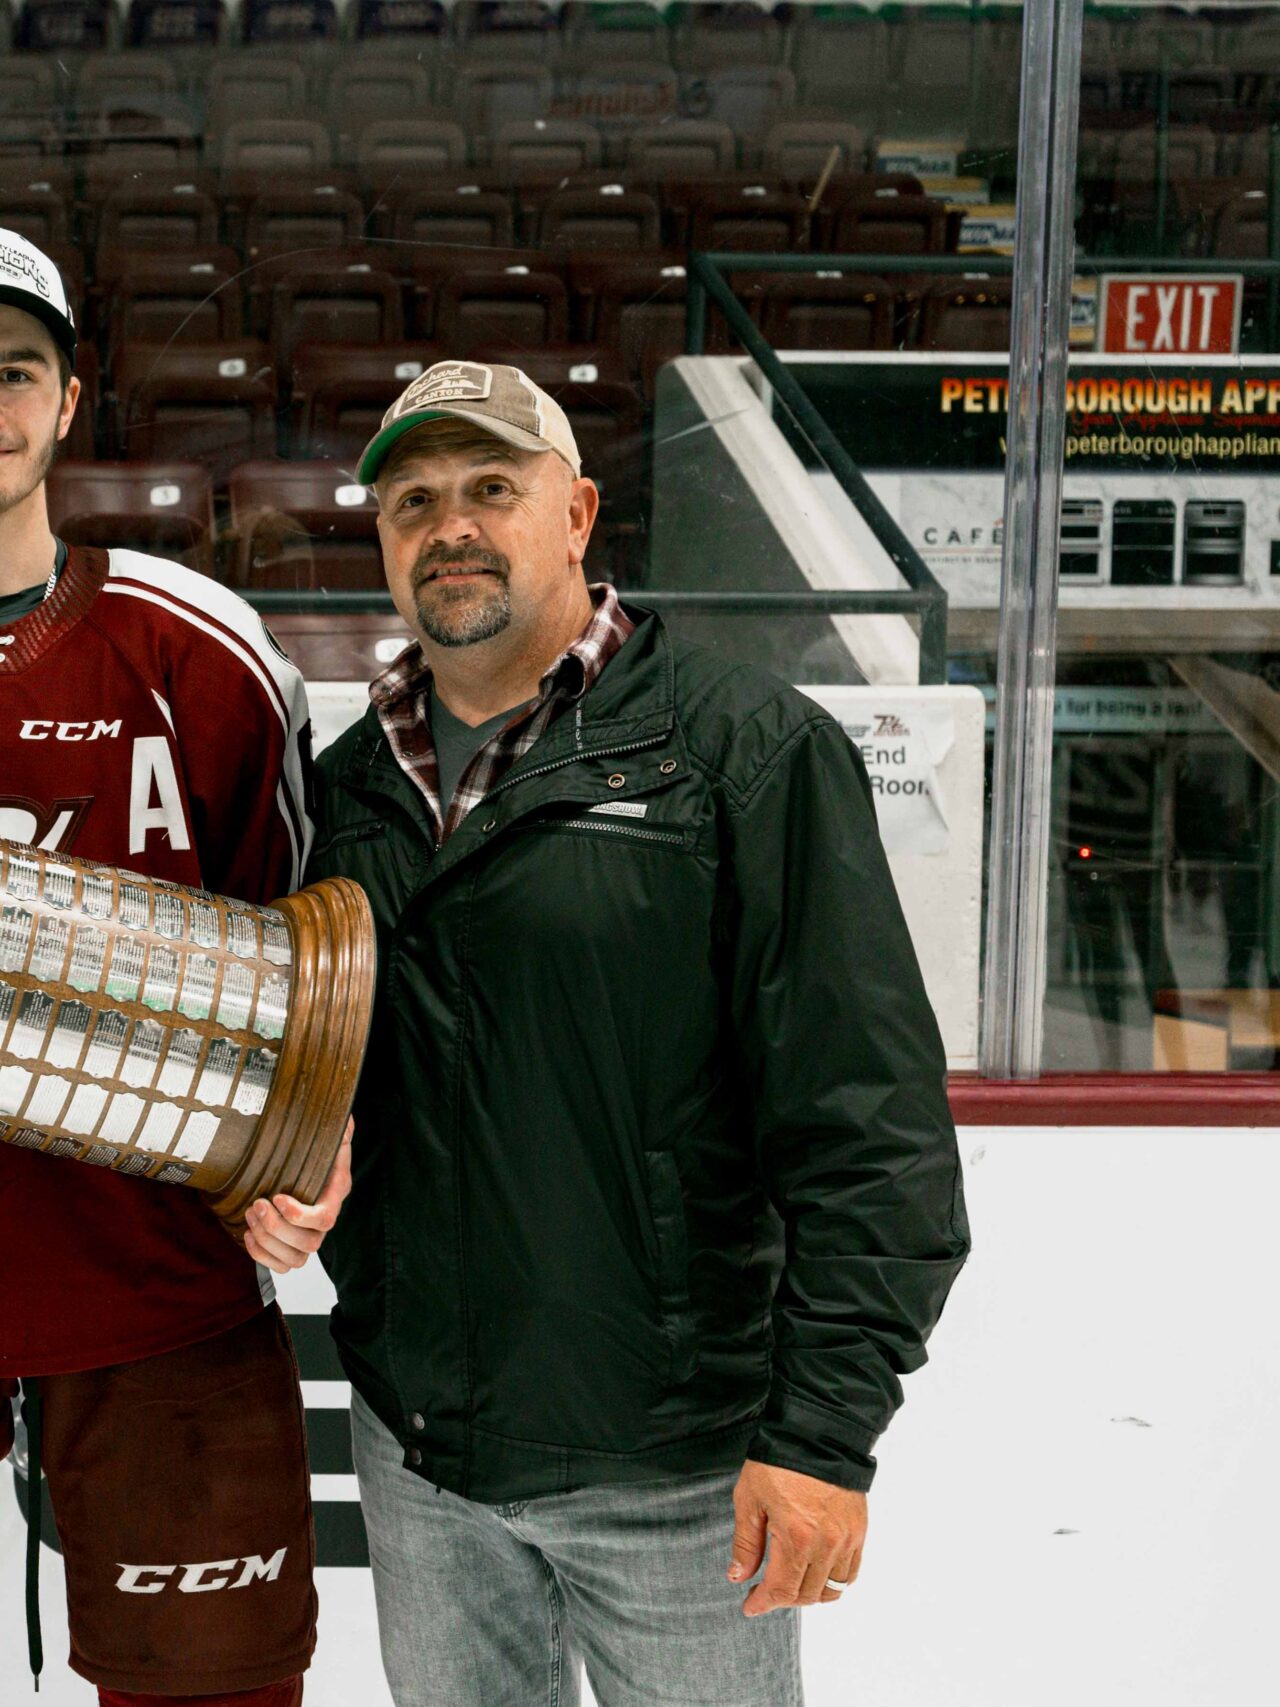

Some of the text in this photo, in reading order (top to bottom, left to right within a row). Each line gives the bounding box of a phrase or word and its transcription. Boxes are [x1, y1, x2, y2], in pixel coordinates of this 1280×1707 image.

[6, 247, 36, 264] LEAGUE
[1124, 285, 1220, 350] EXIT
[941, 378, 1211, 413] PETOROUGH
[999, 432, 1280, 459] peterboroughapplian
[20, 719, 122, 741] CCM
[130, 737, 190, 854] A
[116, 1547, 287, 1593] CCM
